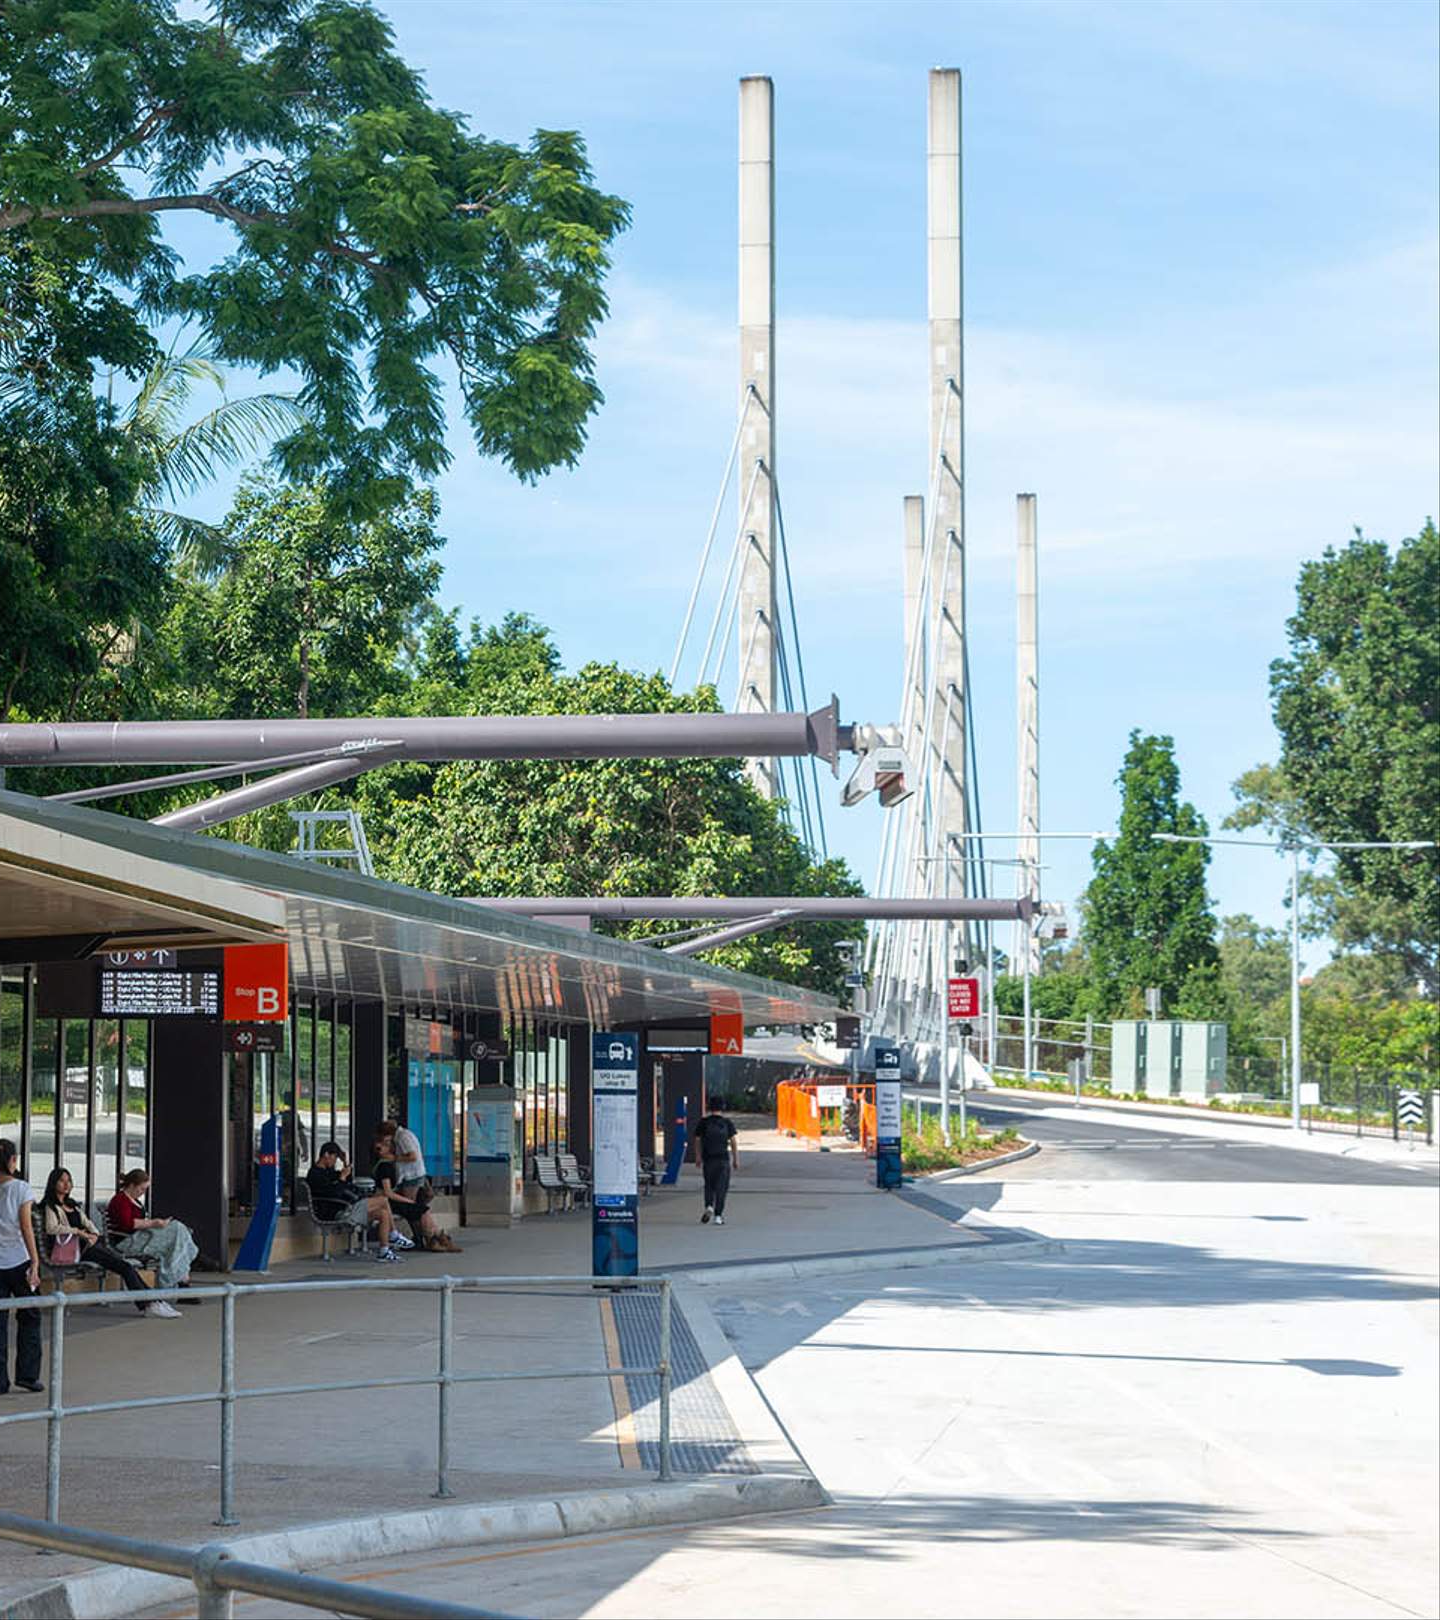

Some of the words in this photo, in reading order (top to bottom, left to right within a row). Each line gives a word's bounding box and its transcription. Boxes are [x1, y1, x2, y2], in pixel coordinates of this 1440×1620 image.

[235, 986, 256, 997] Stop
[257, 987, 280, 1014] B
[727, 1038, 740, 1052] A
